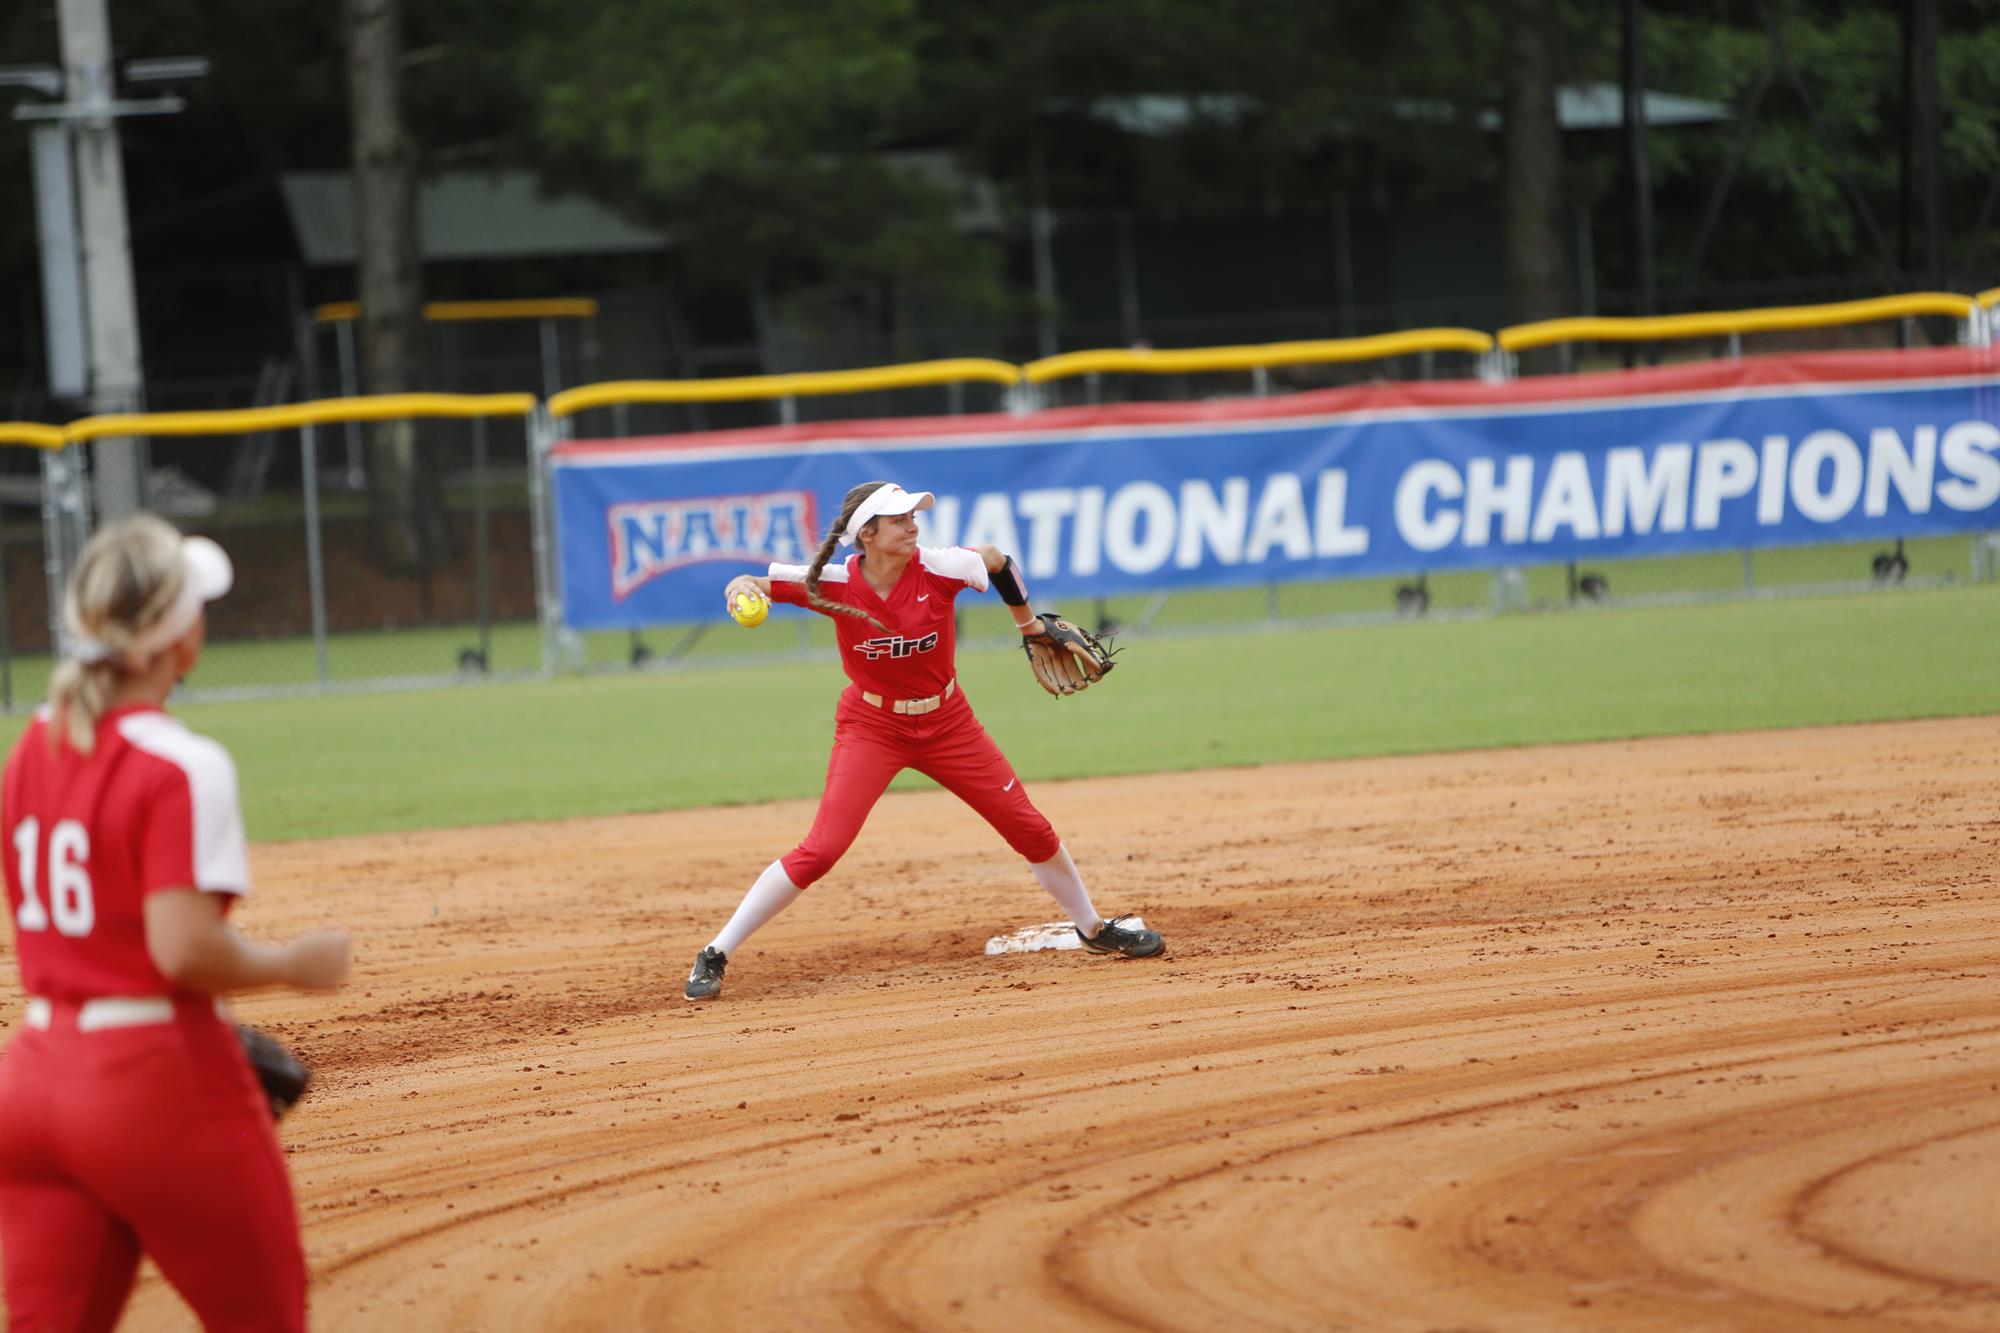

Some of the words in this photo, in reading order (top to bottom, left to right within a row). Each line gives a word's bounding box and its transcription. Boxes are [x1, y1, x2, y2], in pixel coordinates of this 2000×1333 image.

[1393, 420, 2000, 552] CHAMPIONS
[618, 501, 808, 578] NAIA
[853, 631, 938, 660] Fire
[13, 815, 95, 937] 16
